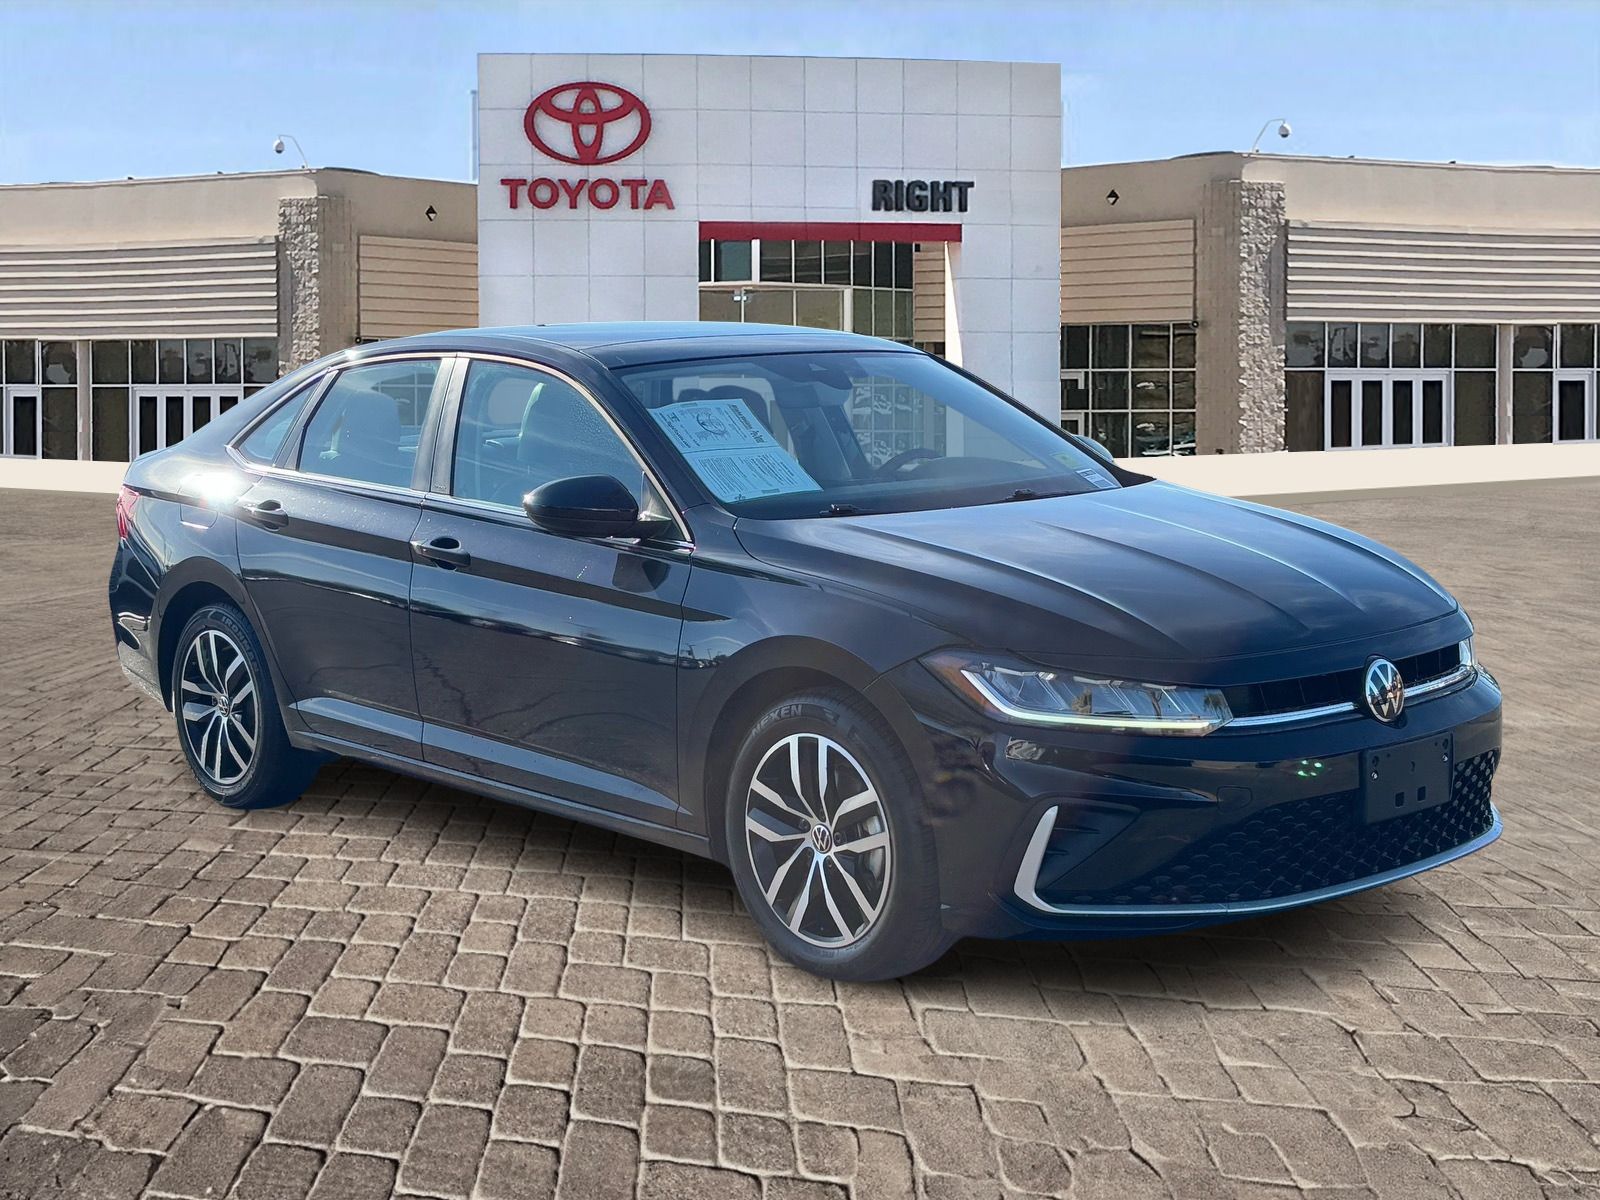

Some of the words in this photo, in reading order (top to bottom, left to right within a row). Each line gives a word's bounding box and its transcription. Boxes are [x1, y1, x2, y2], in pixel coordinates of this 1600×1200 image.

[500, 177, 675, 210] TOYOTA
[871, 179, 975, 213] RIGHT
[751, 703, 803, 738] NEXEN
